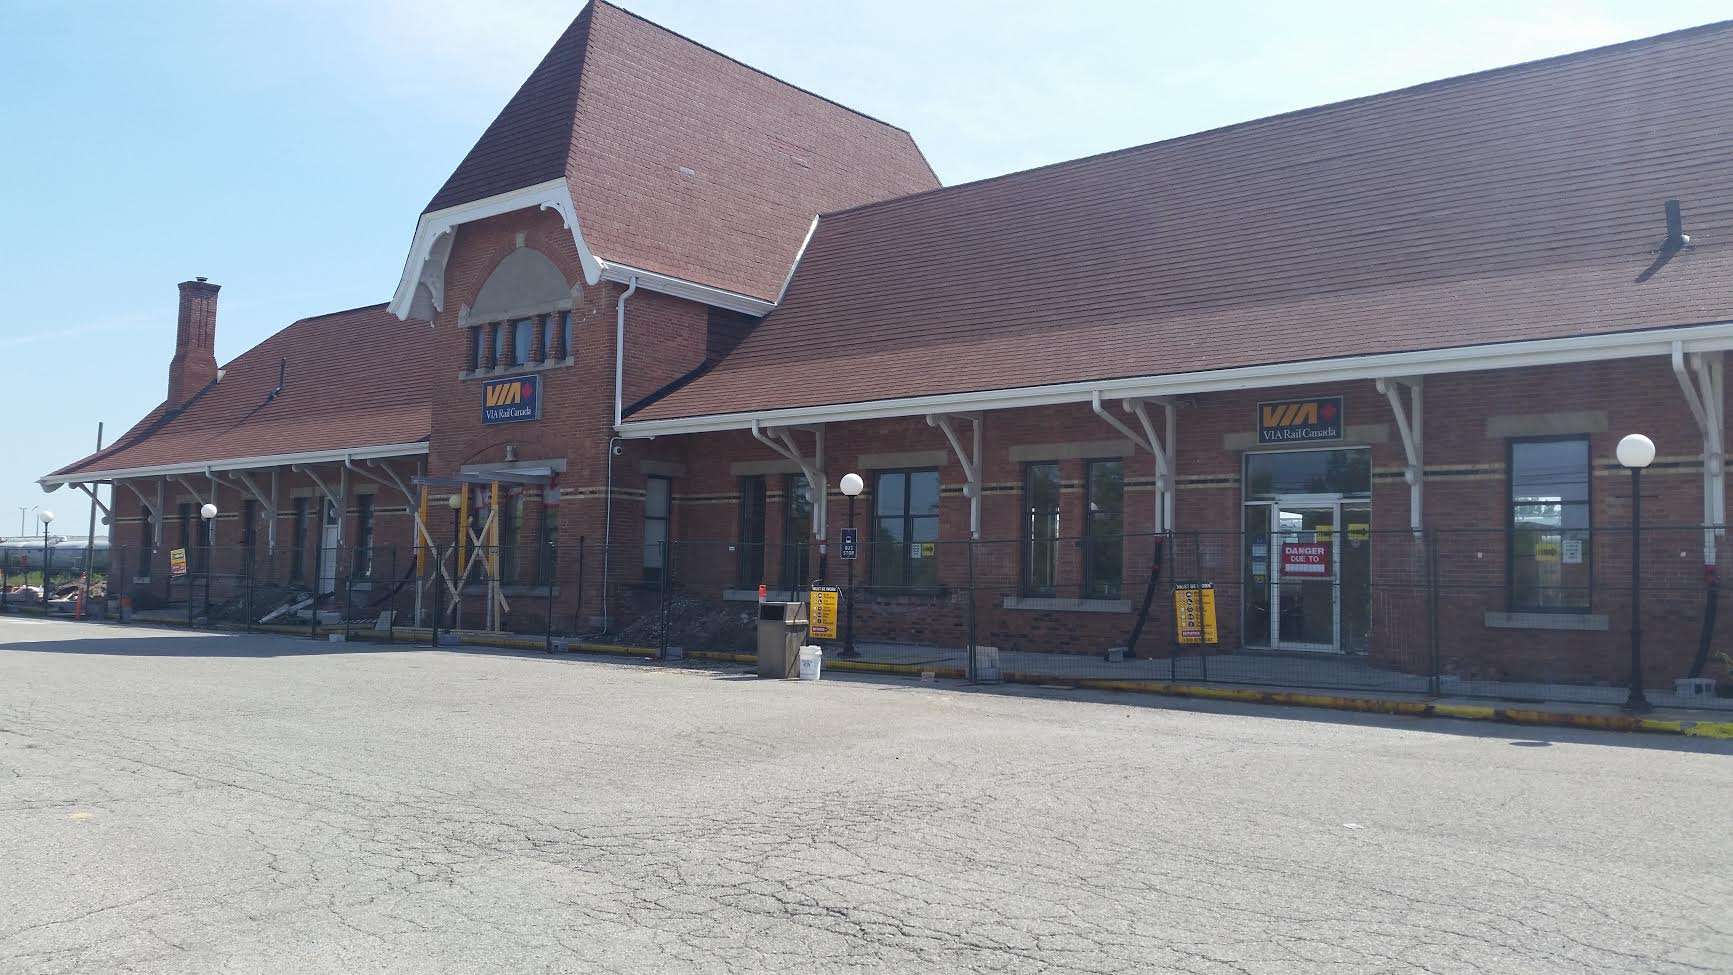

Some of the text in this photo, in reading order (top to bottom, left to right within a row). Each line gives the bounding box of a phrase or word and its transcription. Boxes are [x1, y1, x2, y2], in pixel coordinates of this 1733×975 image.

[486, 382, 520, 406] VIA
[486, 406, 532, 419] VIA Rail Canada
[1263, 403, 1318, 428] VIA
[1263, 426, 1337, 440] VIA Rail Canada
[1285, 547, 1325, 555] DANGER
[1290, 555, 1320, 563] DUE TO
